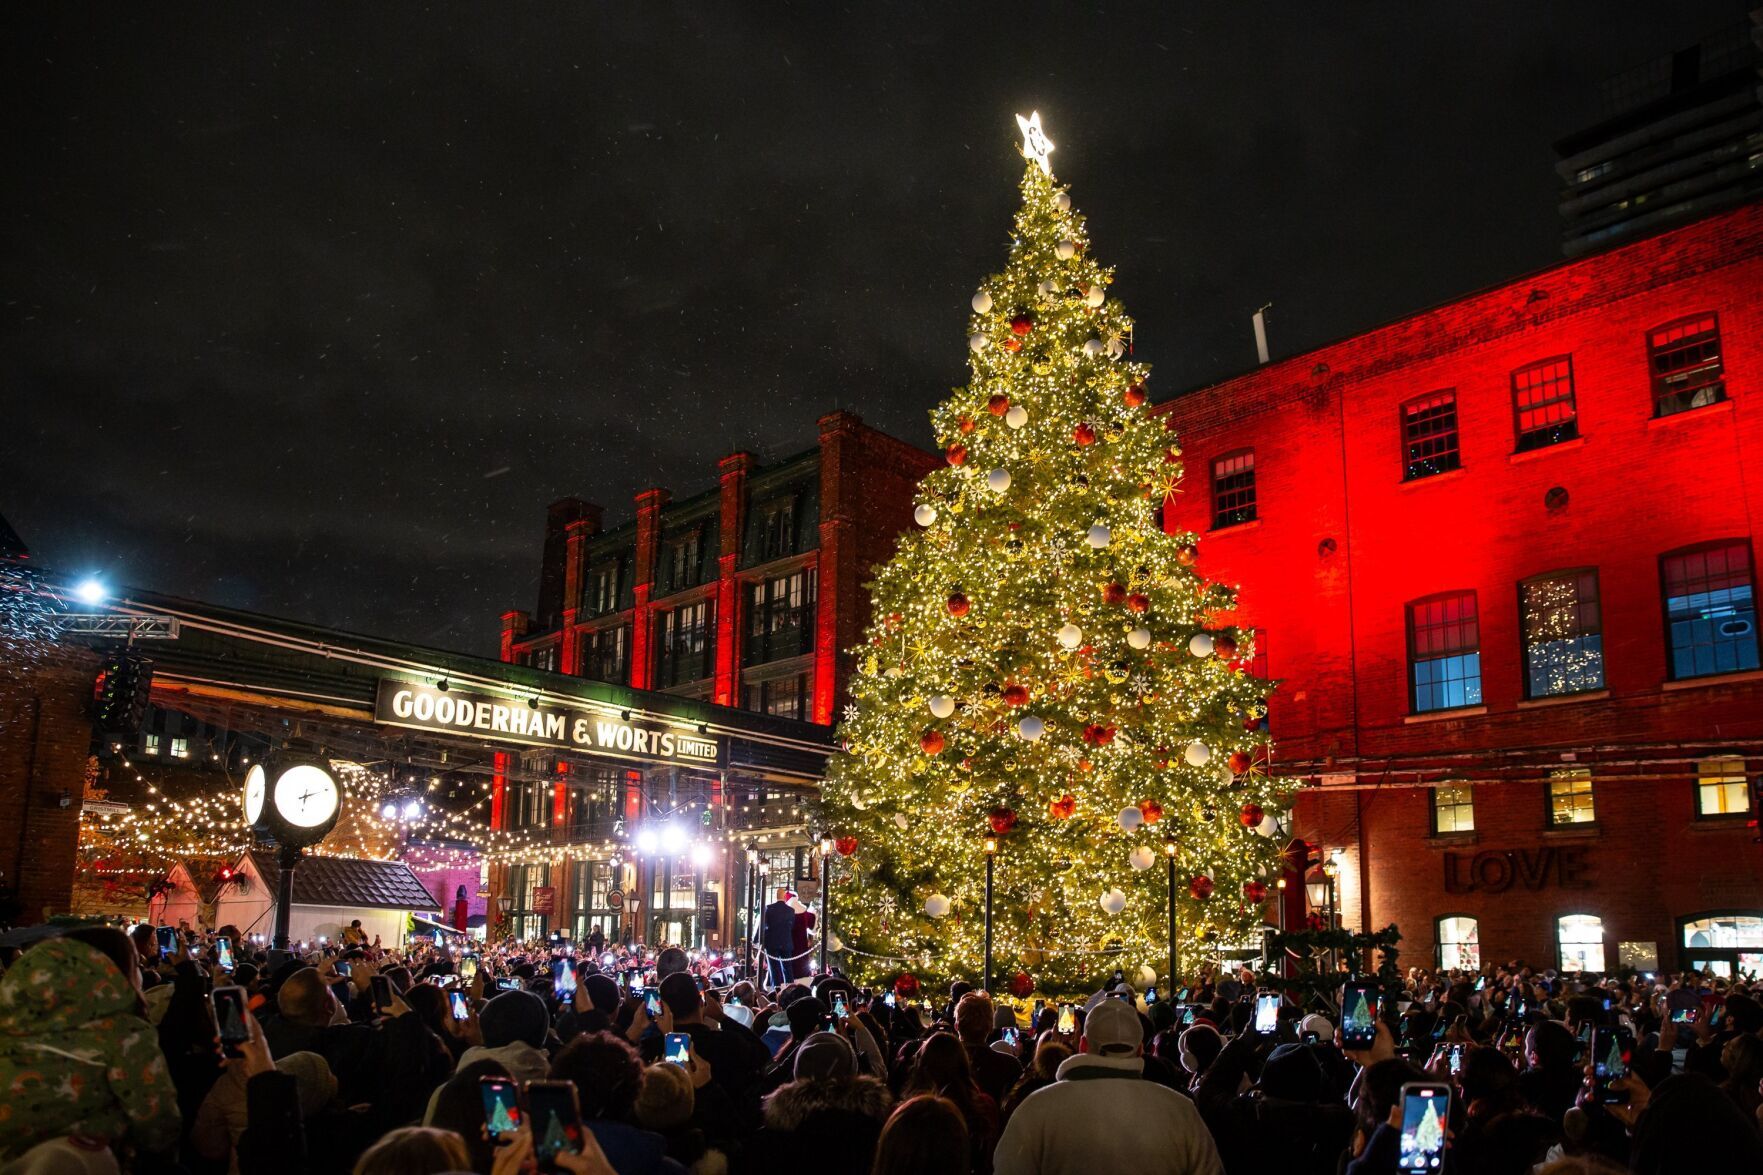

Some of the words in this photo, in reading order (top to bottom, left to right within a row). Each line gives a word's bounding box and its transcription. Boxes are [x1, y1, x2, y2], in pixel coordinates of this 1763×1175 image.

[393, 692, 565, 740] GOODERHAM
[572, 720, 592, 746] &
[596, 723, 675, 757] WORTS
[677, 739, 717, 758] LIMITED
[1444, 846, 1590, 893] LOVE
